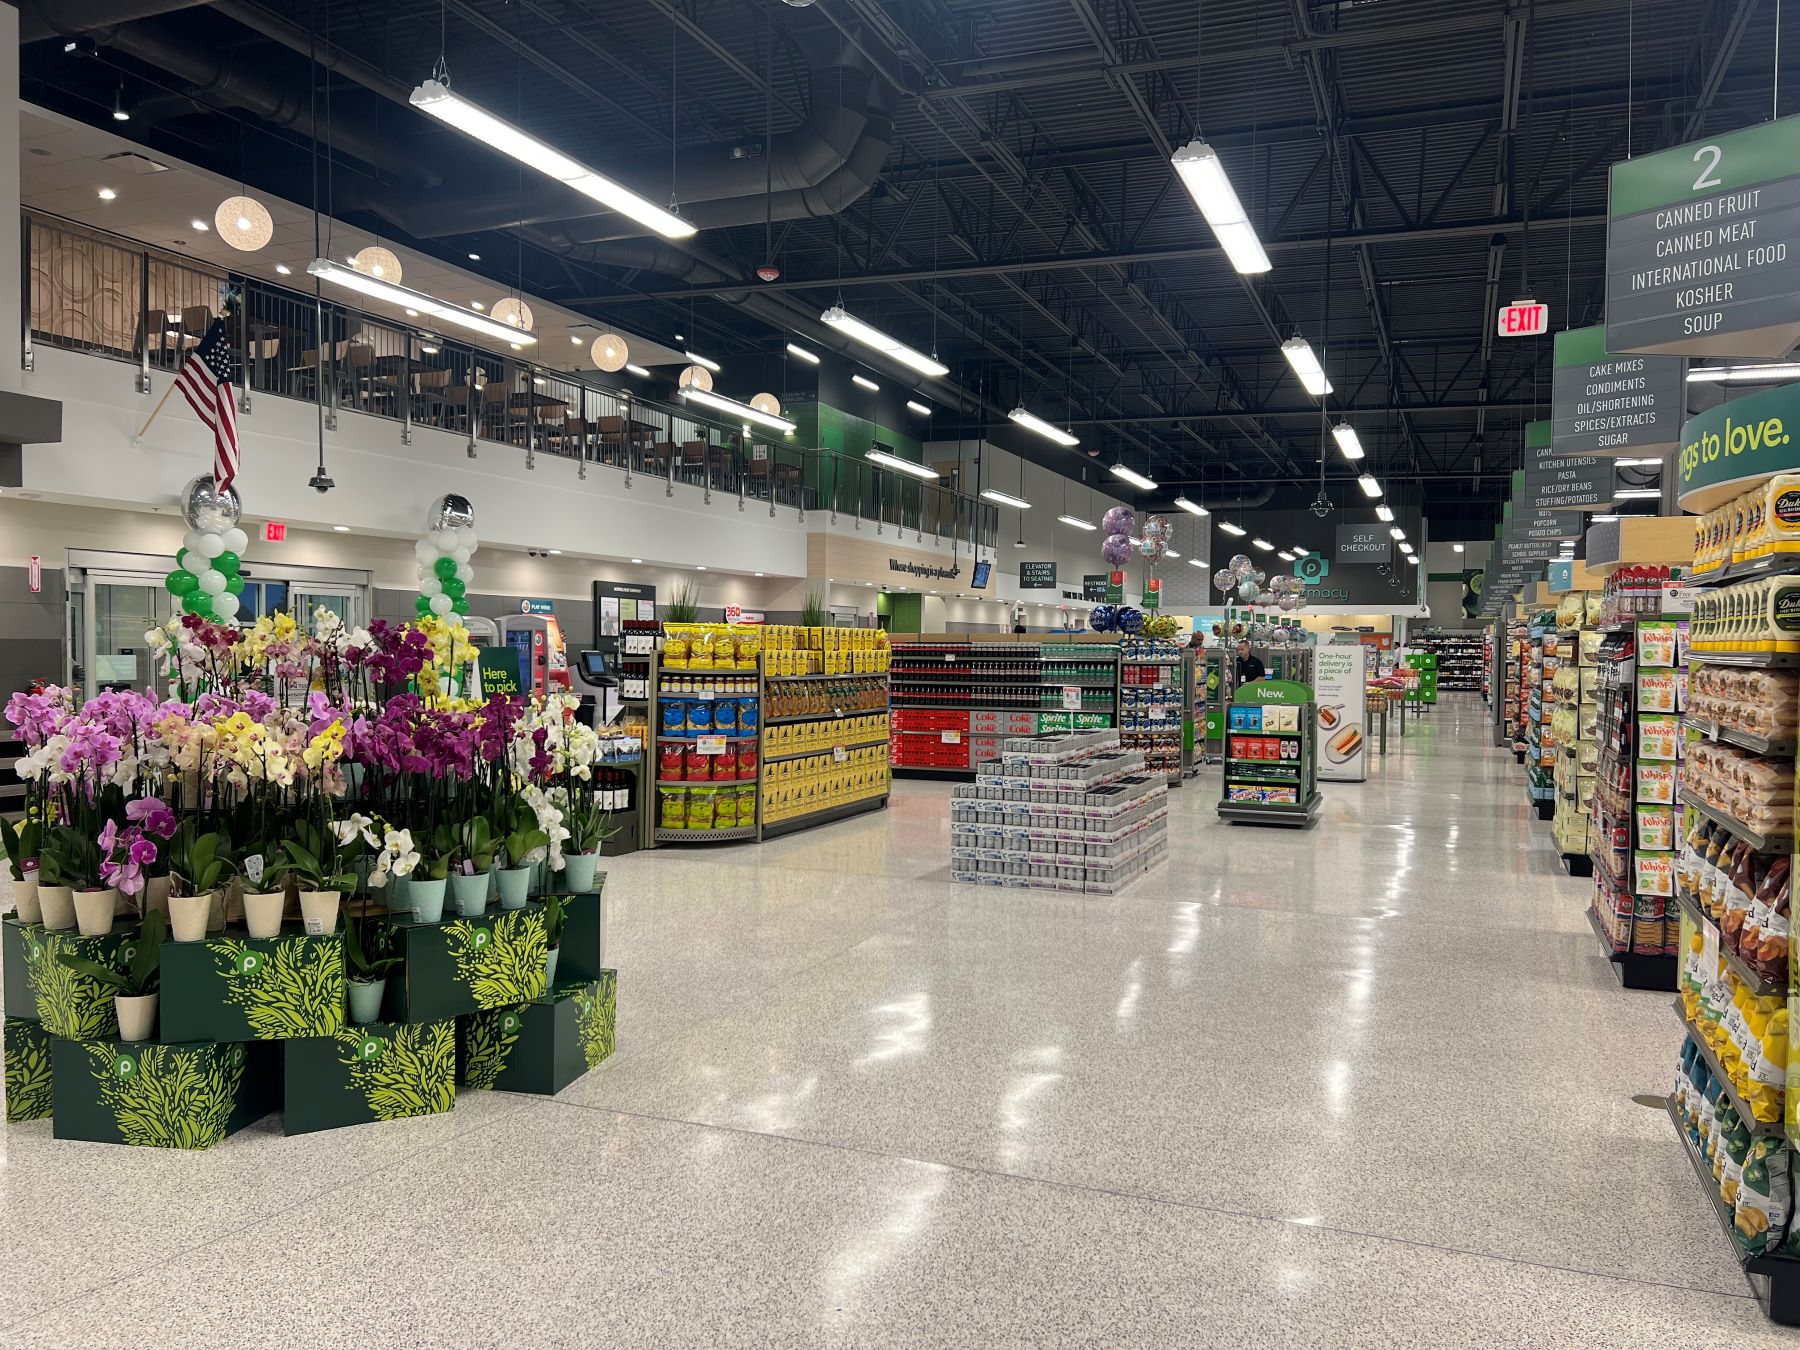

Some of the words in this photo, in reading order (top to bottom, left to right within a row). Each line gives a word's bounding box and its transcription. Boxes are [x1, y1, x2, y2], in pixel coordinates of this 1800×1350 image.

[1692, 145, 1722, 191] 2
[1656, 201, 1712, 230] CANNED
[1718, 190, 1761, 215] FRUIT
[1656, 230, 1713, 258] CANNED
[1719, 220, 1757, 242] MEAT
[1631, 252, 1741, 291] INTERNATIONAL
[1747, 243, 1787, 268] FOOD
[1675, 282, 1733, 309] KOSHER
[1506, 305, 1542, 333] EXIT
[1683, 312, 1723, 335] SOUP
[1589, 362, 1612, 378] CAKE
[1615, 358, 1644, 374] MIXES
[1586, 377, 1646, 396] CONDIMENTS
[1577, 394, 1655, 415] OIL/SHORTENING
[1574, 412, 1656, 433] SPICES/EXTRACTS
[1598, 432, 1629, 448] SUGAR
[1701, 431, 1720, 464] to
[1724, 417, 1790, 457] love.
[1536, 448, 1552, 458] CANN
[1538, 459, 1565, 470] KITCHEN
[1566, 457, 1597, 467] UTENSILS
[1557, 471, 1577, 480] PASTA
[1541, 483, 1570, 495] RICE/DRY
[1571, 482, 1592, 492] BEANS
[1535, 494, 1598, 507] STUFFING/POTATOES
[1777, 498, 1800, 509] Duk
[1533, 519, 1557, 527] POPCORN
[1528, 529, 1546, 537] POTATO
[1546, 528, 1562, 536] CHIPS
[1353, 535, 1374, 543] SELF
[1341, 544, 1386, 552] CHECKOUT
[1643, 633, 1673, 644] Whisps
[1318, 660, 1346, 668] delivery
[482, 668, 508, 680] Here
[484, 682, 495, 693] to
[496, 680, 518, 694] pick
[1642, 678, 1674, 688] Whisps
[1257, 688, 1284, 698] New.
[975, 712, 997, 721] Coke
[1009, 713, 1032, 722] Coke
[1040, 713, 1066, 723] Sprite
[1076, 714, 1103, 724] Sprite
[975, 723, 997, 732] Coke
[1009, 724, 1031, 733] Coke
[1643, 726, 1676, 736] Whisps
[975, 738, 997, 746] Coke
[975, 749, 996, 758] Coke
[1640, 770, 1673, 780] Whisps
[1642, 816, 1672, 827] Whisps
[1640, 861, 1672, 872] Whisps
